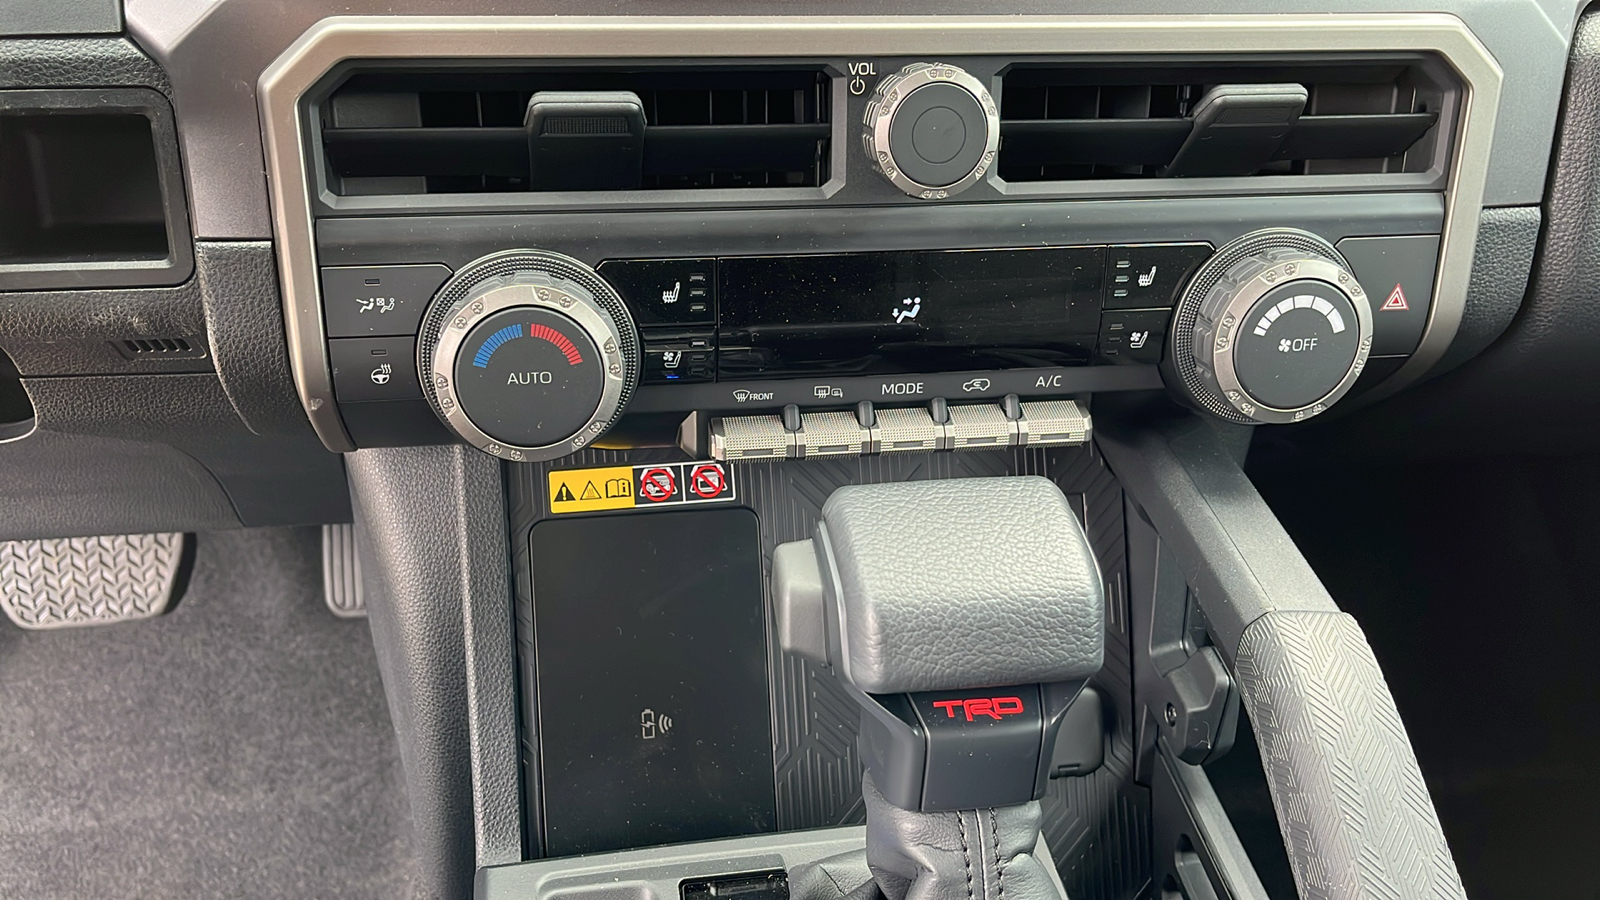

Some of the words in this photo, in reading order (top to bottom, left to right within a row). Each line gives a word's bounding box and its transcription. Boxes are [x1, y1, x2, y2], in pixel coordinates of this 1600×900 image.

[848, 63, 876, 75] VOL
[1292, 338, 1318, 351] OFF
[507, 371, 552, 385] AUTO
[1035, 375, 1062, 388] A/C
[882, 382, 924, 395] MODE
[749, 391, 774, 401] FRONT
[933, 697, 1024, 721] TRD
